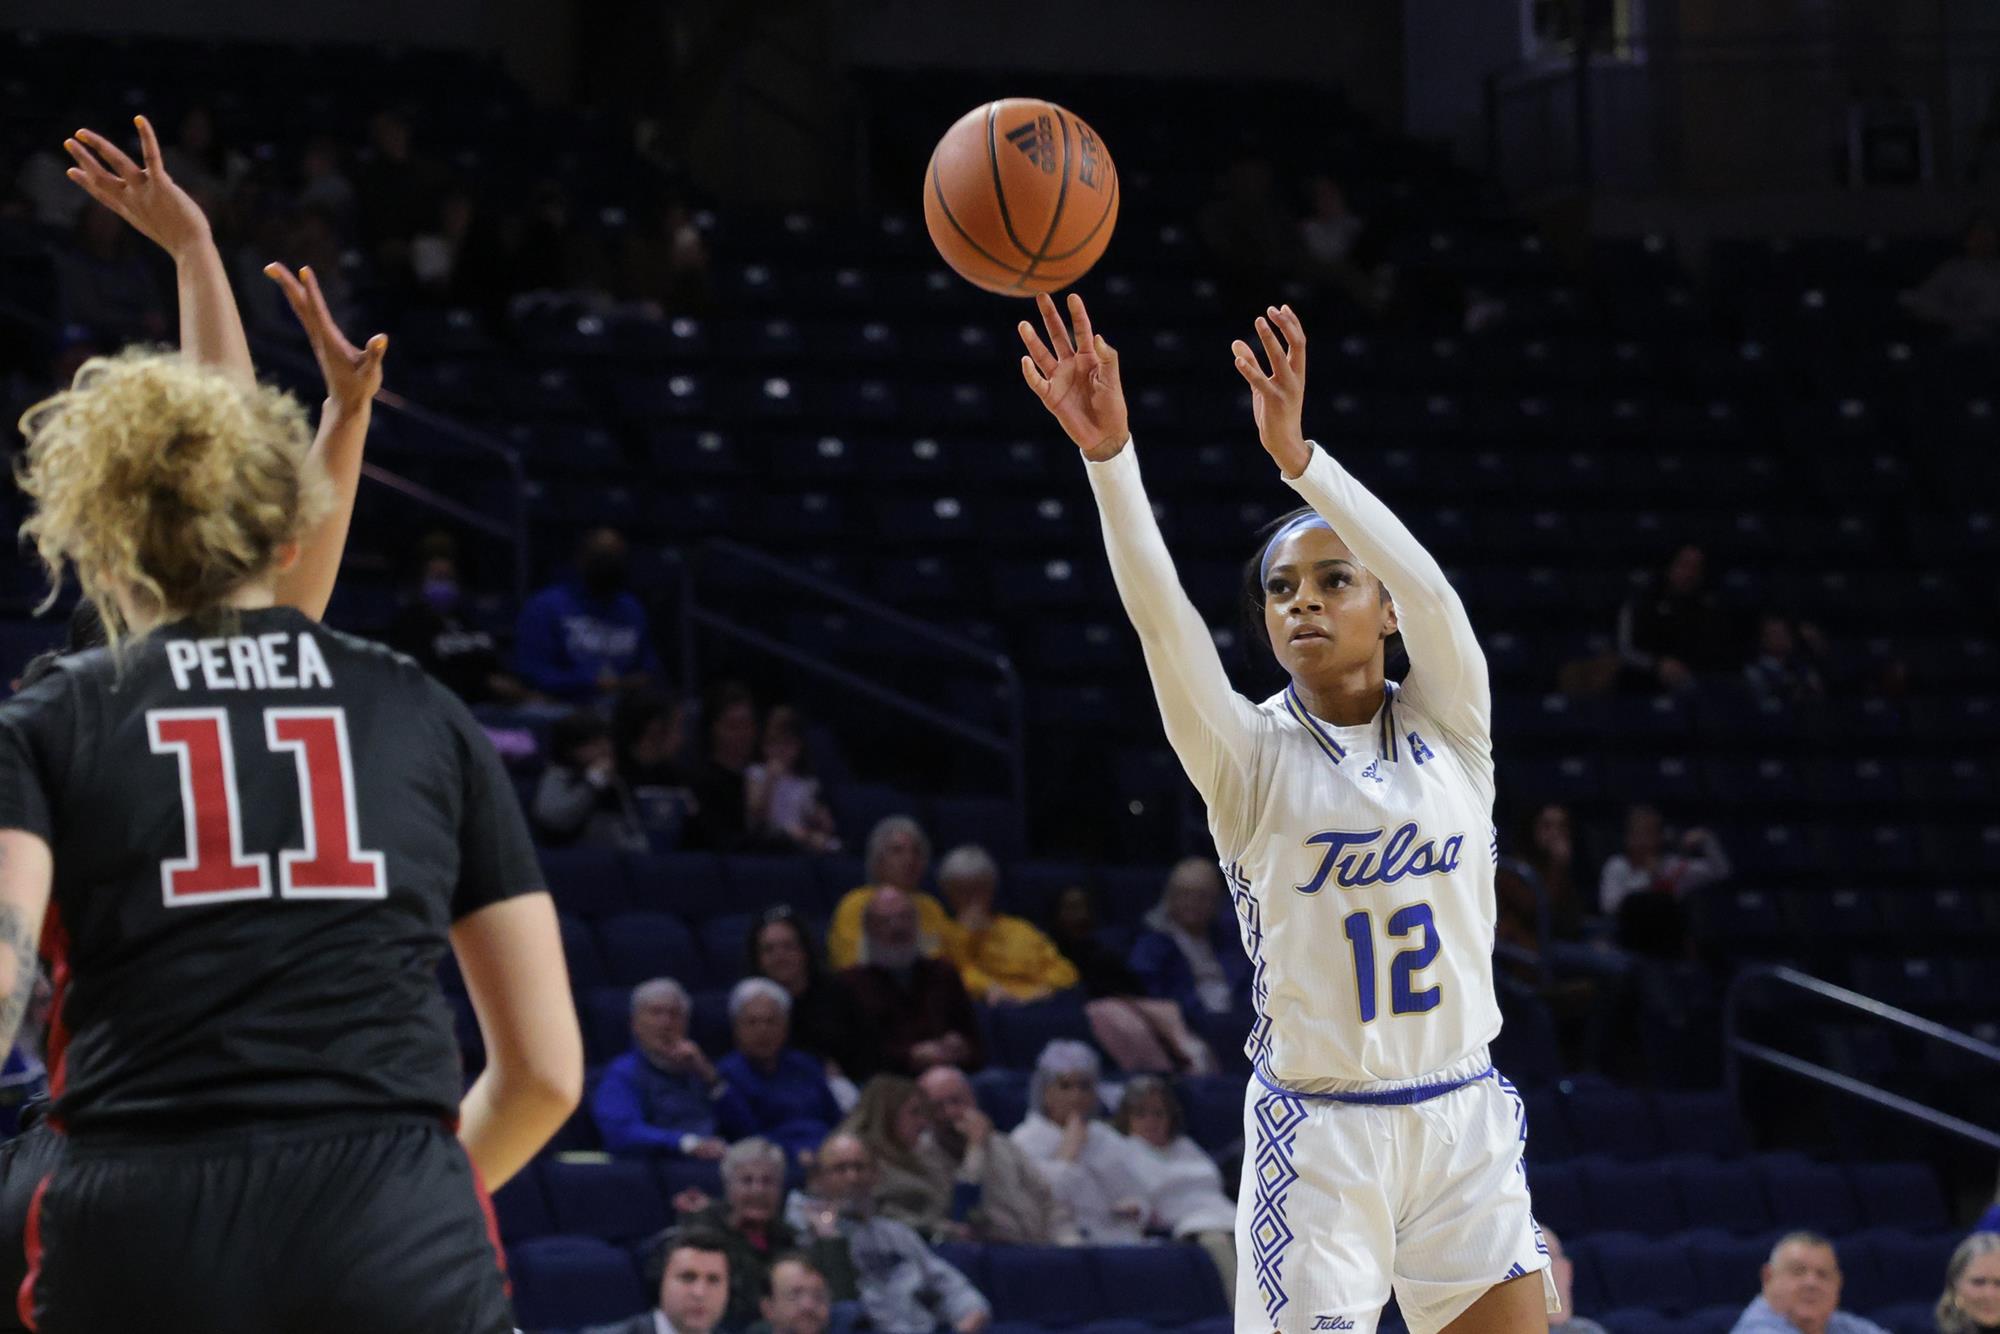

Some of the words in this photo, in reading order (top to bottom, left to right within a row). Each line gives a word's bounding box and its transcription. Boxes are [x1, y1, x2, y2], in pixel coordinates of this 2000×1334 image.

[166, 632, 333, 690] PEREA
[146, 706, 388, 908] 11
[1293, 820, 1465, 897] Tulsa
[1342, 901, 1442, 1024] 12
[1310, 1315, 1355, 1331] Tulsa
